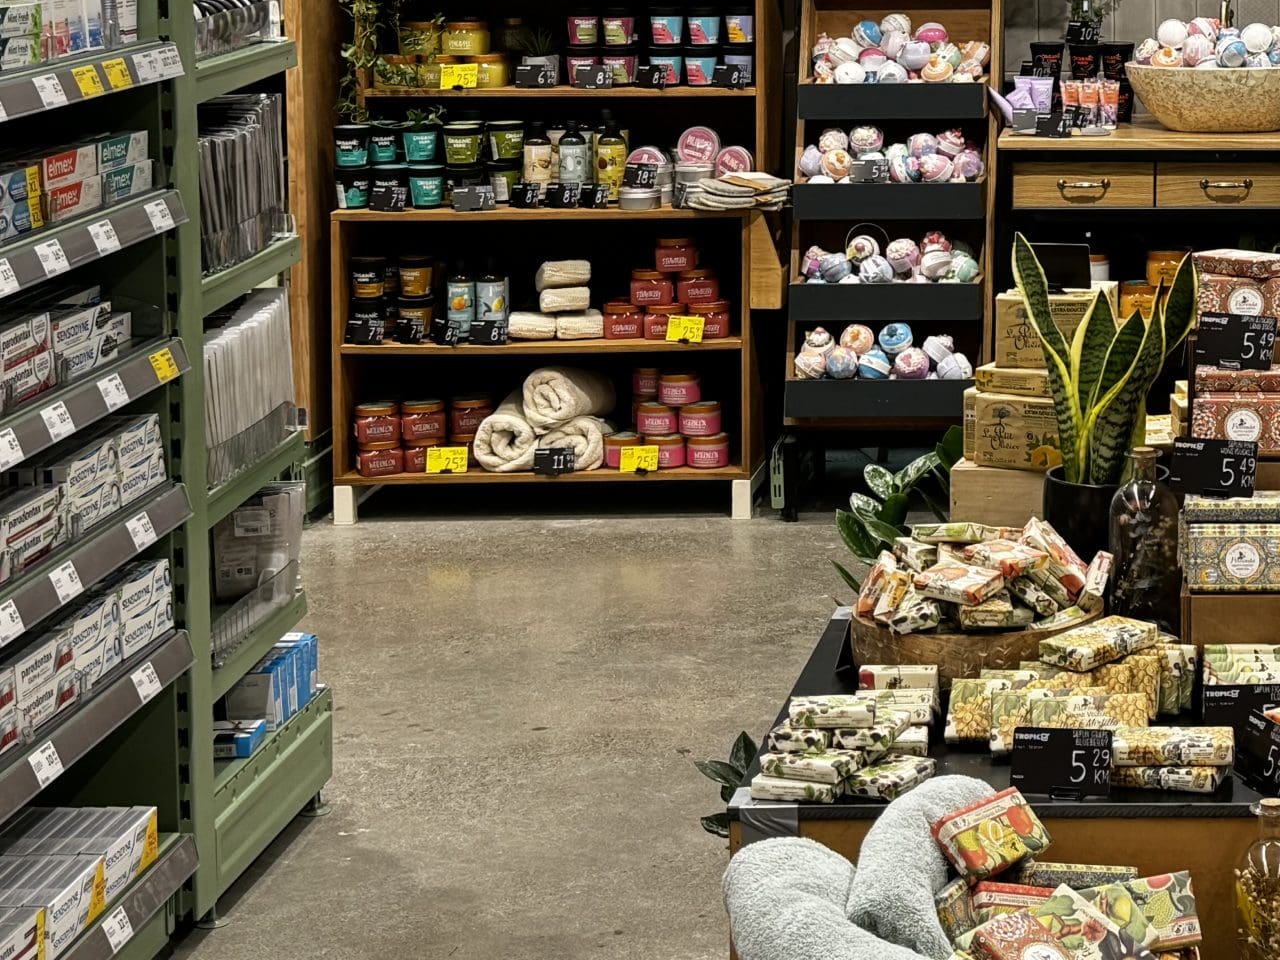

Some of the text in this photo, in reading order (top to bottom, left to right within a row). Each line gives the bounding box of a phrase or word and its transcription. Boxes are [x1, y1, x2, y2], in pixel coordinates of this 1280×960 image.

[1080, 28, 1093, 41] 10
[538, 72, 545, 84] 6
[103, 144, 127, 161] elmex
[48, 158, 74, 178] elmex
[872, 166, 879, 178] 5
[637, 171, 648, 184] 18
[1241, 332, 1274, 358] 5 49
[553, 456, 564, 469] 11
[1220, 458, 1256, 486] 5 49
[1241, 476, 1255, 488] KM
[8, 504, 42, 533] parodontax
[21, 651, 53, 679] parodontax
[1070, 749, 1110, 782] 5 29
[1263, 745, 1278, 777] 5
[1094, 769, 1110, 784] KM
